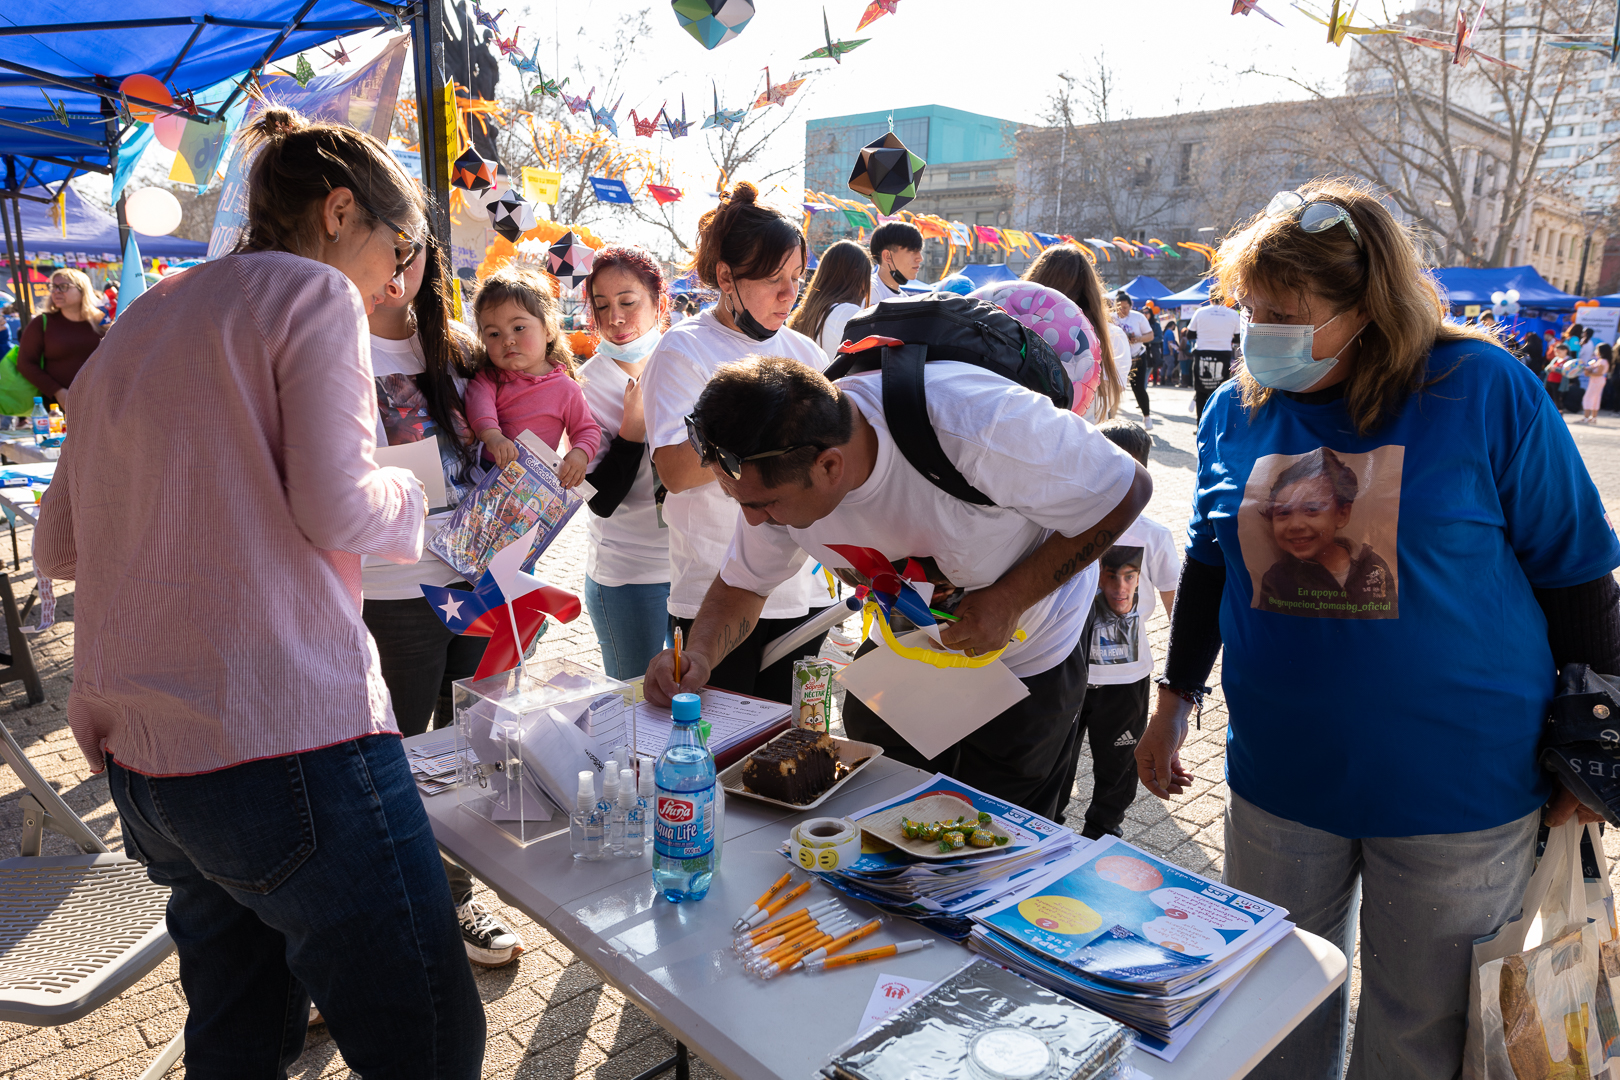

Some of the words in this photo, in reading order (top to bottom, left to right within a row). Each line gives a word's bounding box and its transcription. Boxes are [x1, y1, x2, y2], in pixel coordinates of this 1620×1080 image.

[1298, 587, 1308, 596] En
[1311, 590, 1339, 599] apoyo
[804, 682, 826, 690] Soprole
[1114, 739, 1137, 747] adidas
[659, 799, 691, 818] fruna
[654, 817, 674, 840] Aqua
[676, 823, 698, 842] Life
[1240, 900, 1266, 914] fain
